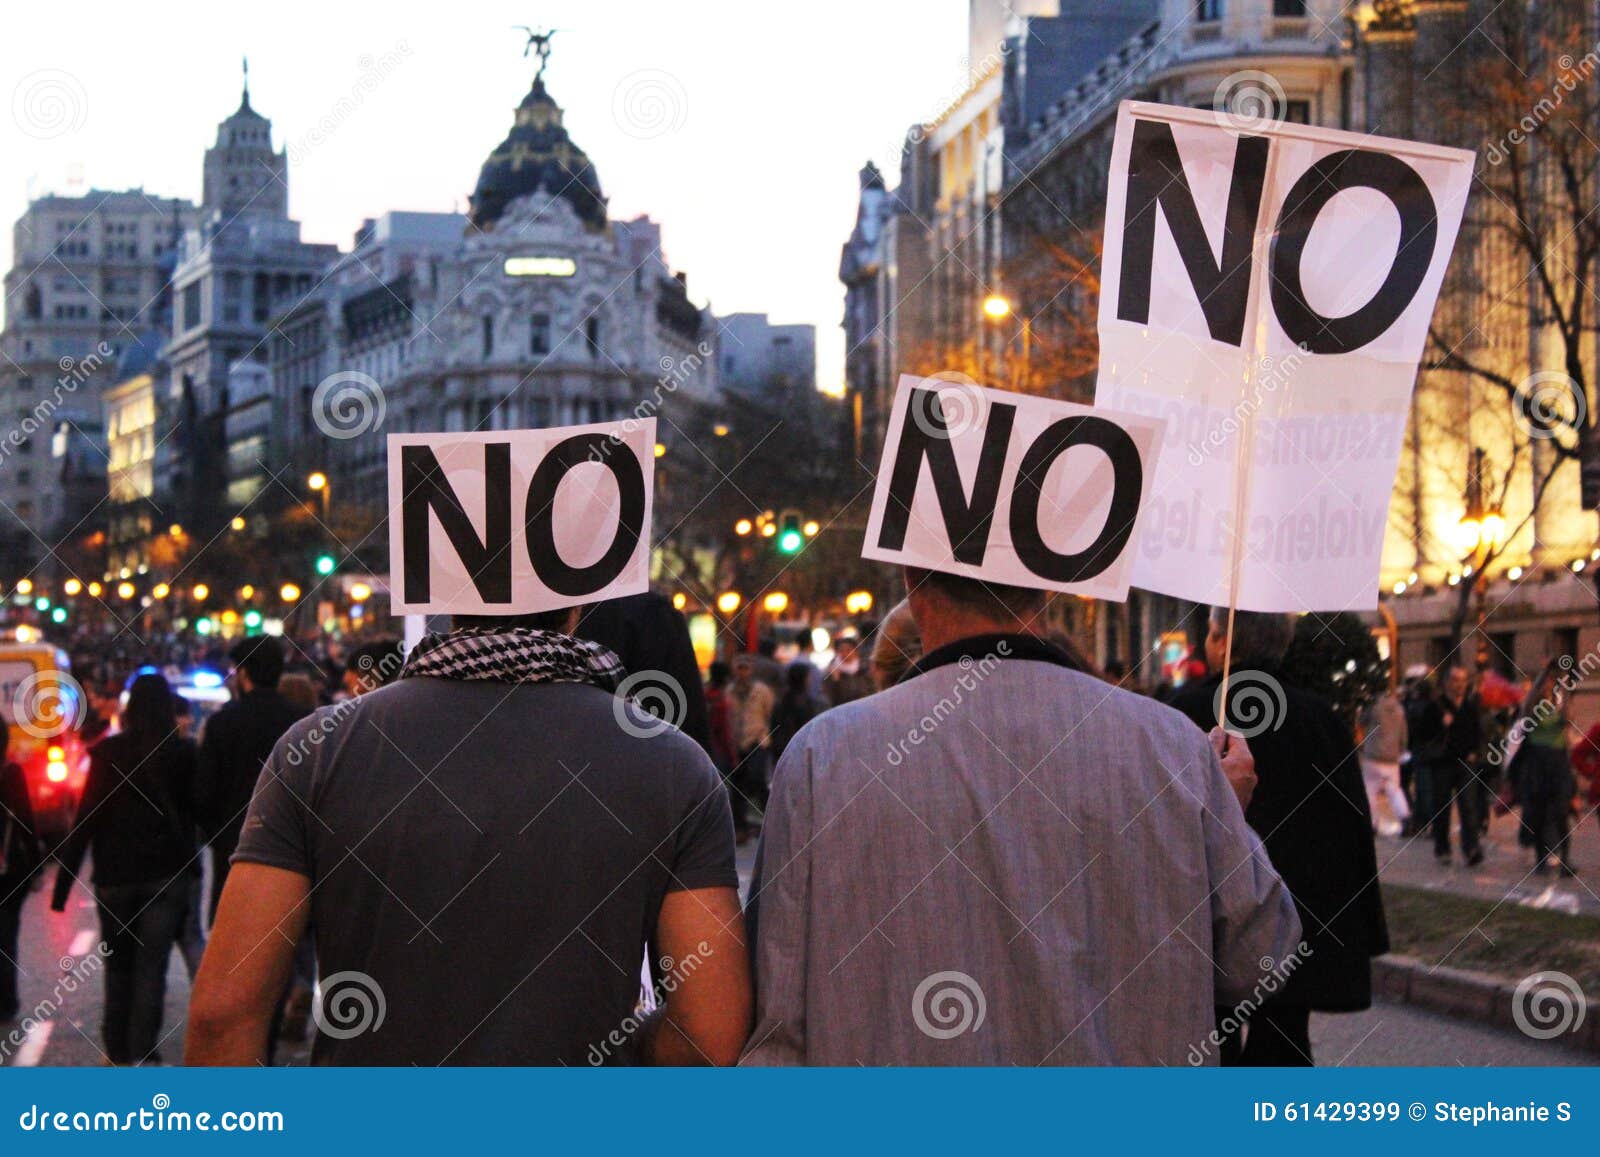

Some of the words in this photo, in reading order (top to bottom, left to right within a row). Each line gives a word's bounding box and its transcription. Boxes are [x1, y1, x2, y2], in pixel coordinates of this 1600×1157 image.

[1118, 119, 1438, 355] NO
[402, 434, 646, 604] NO
[878, 388, 1143, 583] NO
